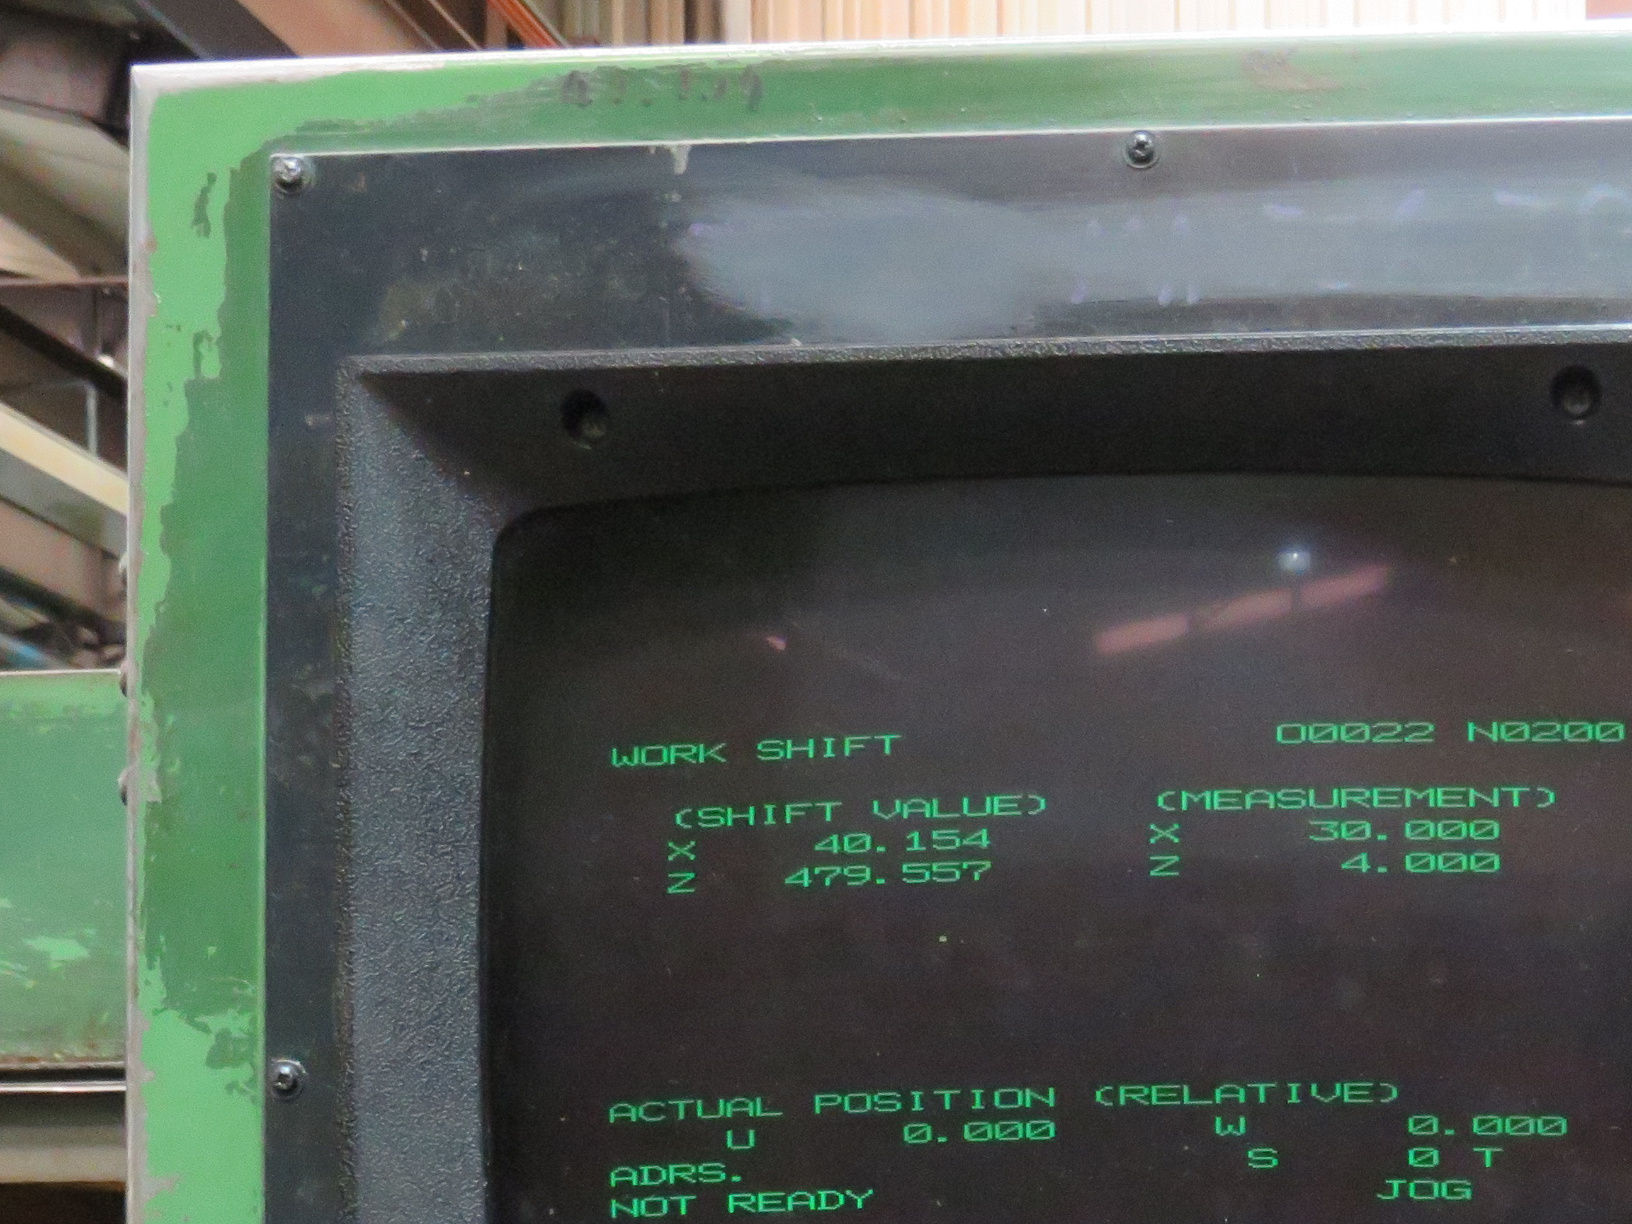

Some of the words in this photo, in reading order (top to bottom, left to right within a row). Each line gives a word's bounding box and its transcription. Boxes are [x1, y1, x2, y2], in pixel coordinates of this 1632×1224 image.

[1467, 721, 1626, 743] N0200
[611, 743, 727, 768] WORK
[757, 734, 902, 760] SHIFT
[675, 802, 843, 829] (SHIFT
[872, 794, 1047, 821] VALUE)
[1157, 787, 1556, 812] (MEASUREMENT)
[668, 840, 697, 861] X
[814, 829, 991, 855] 40.154
[1150, 823, 1181, 844] X
[1308, 819, 1501, 842] 30.000
[668, 872, 697, 894] Z
[785, 861, 992, 888] 479.557
[1150, 855, 1180, 876] Z
[1341, 852, 1501, 873] 4.000
[609, 1097, 783, 1123] ACTUAL
[814, 1087, 1056, 1114] POSITION
[1096, 1082, 1398, 1107] (RELATIVE)
[727, 1129, 755, 1150] U
[903, 1120, 1056, 1144] 0.000
[1215, 1116, 1247, 1137] W
[1408, 1115, 1568, 1136] 0.000
[1247, 1148, 1279, 1169] S
[1408, 1147, 1439, 1168] 0
[1473, 1147, 1503, 1168] T
[609, 1162, 742, 1187] ADRS.
[1377, 1179, 1472, 1201] JOG
[610, 1195, 697, 1219] NOT
[727, 1189, 874, 1215] READY
